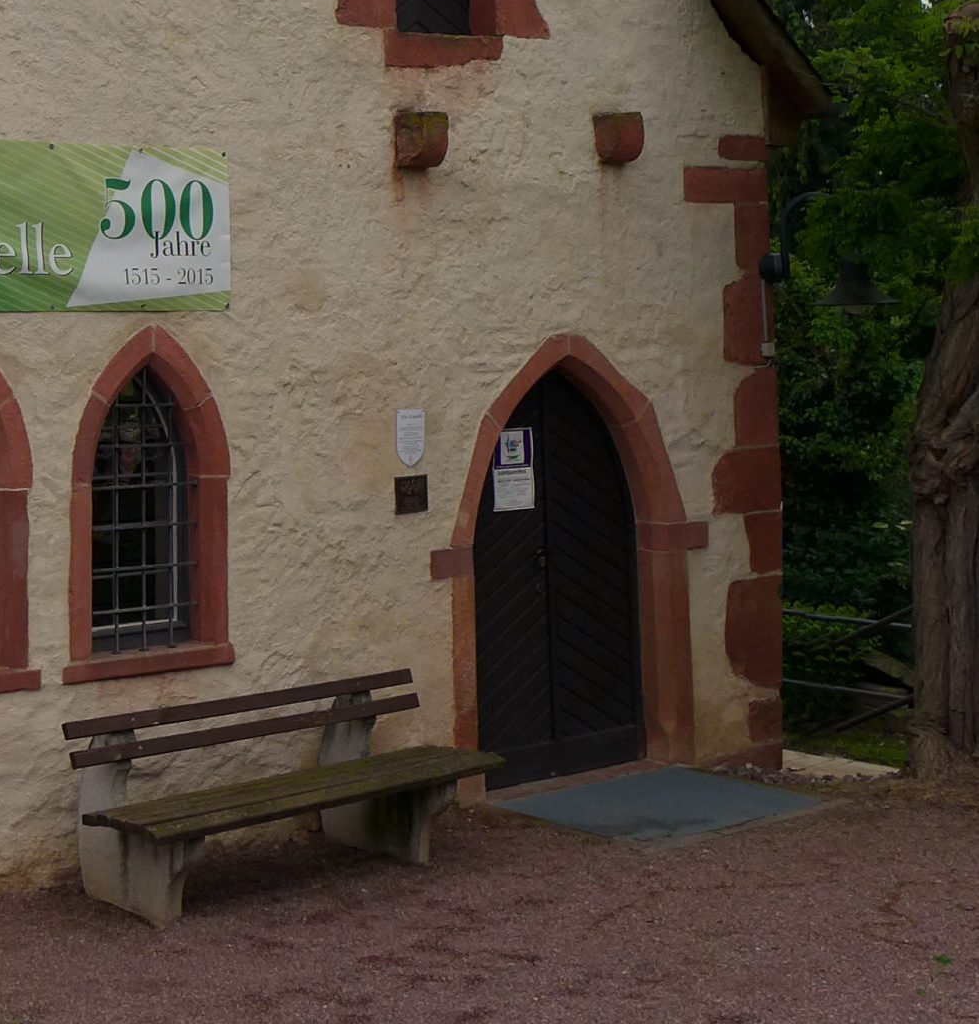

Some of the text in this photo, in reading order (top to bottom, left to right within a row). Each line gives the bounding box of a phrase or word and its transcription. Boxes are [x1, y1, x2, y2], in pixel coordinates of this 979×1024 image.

[100, 177, 214, 241] 500
[149, 230, 212, 259] Jahre
[123, 267, 161, 286] 1515
[176, 267, 214, 286] 2015
